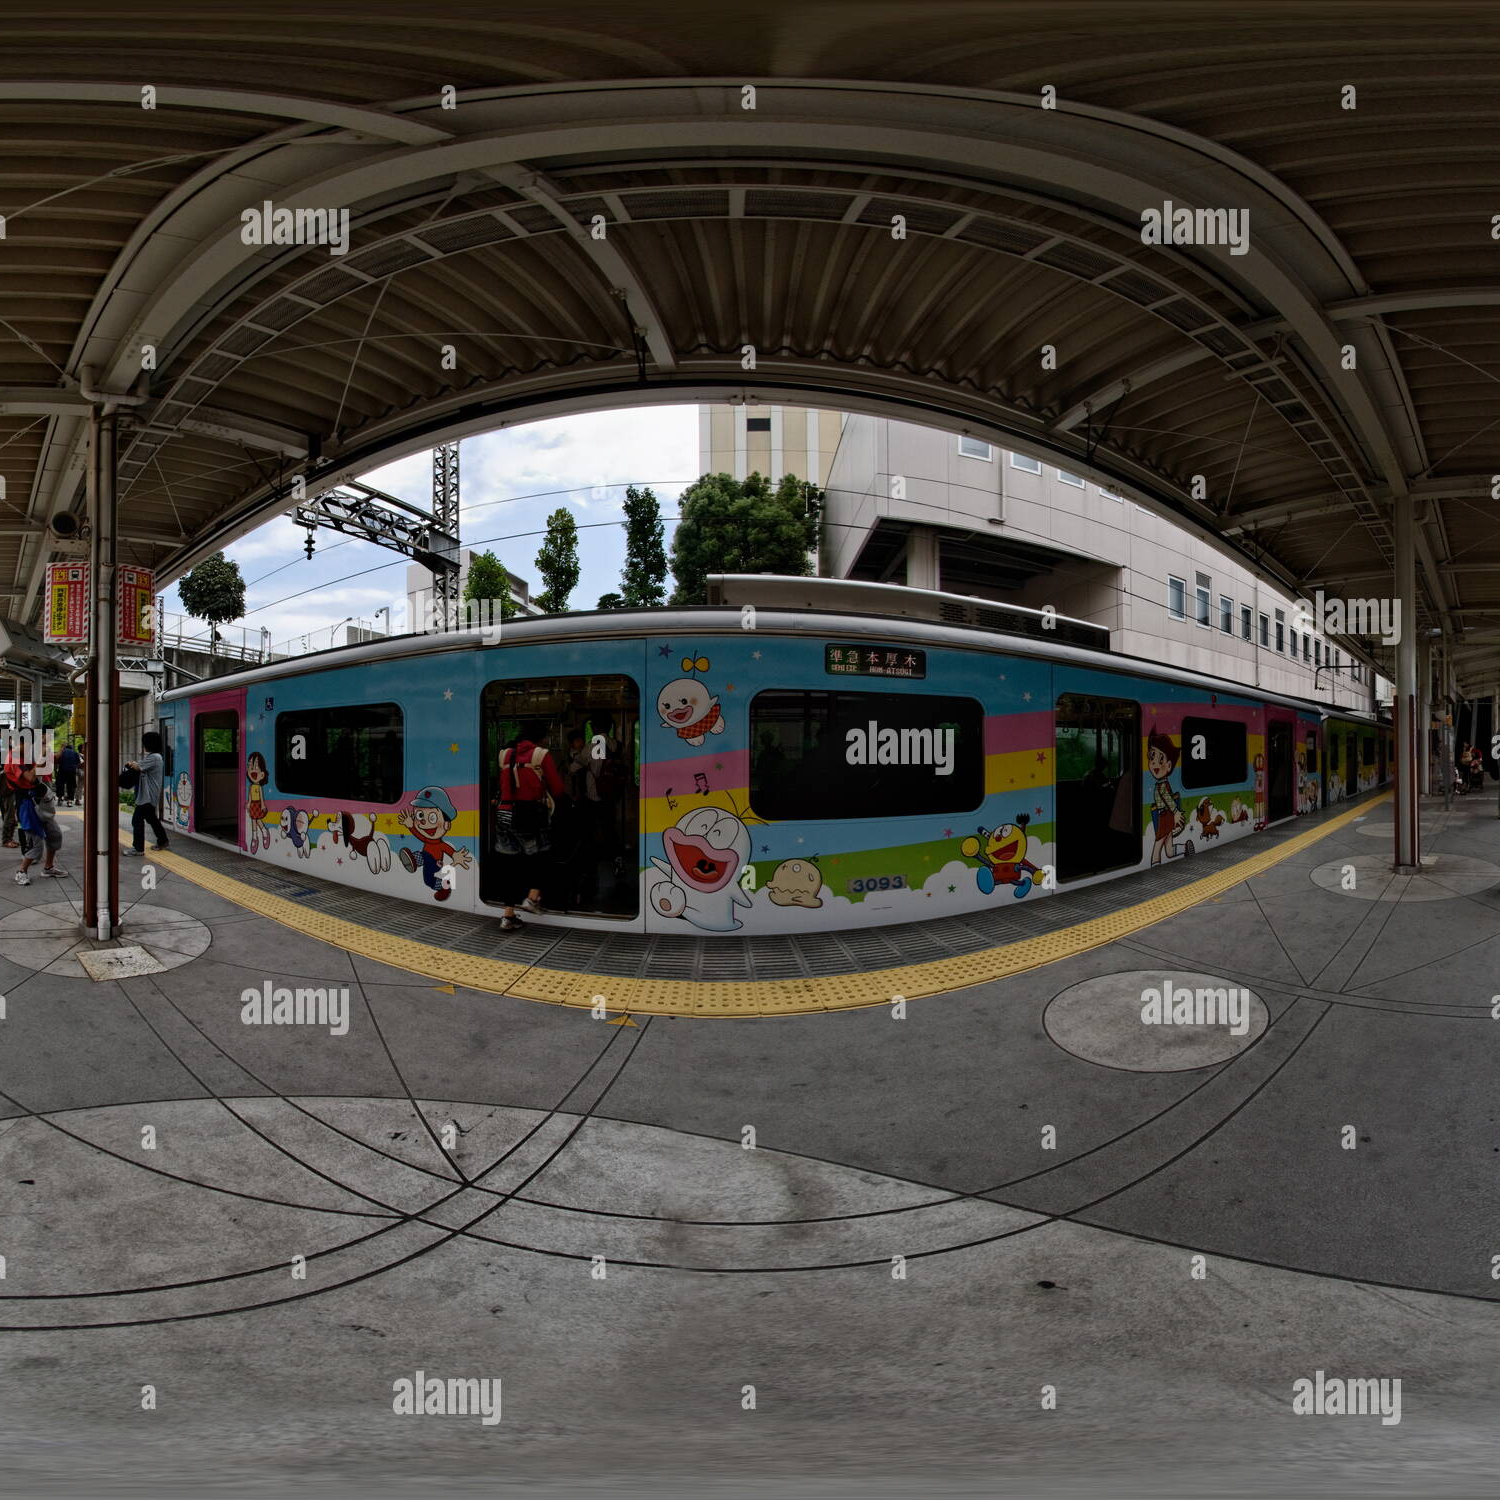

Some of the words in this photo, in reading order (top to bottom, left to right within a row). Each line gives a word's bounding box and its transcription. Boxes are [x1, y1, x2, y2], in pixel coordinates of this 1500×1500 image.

[829, 648, 859, 664] 準急
[866, 651, 917, 668] 本厚木
[853, 876, 903, 892] 3093
